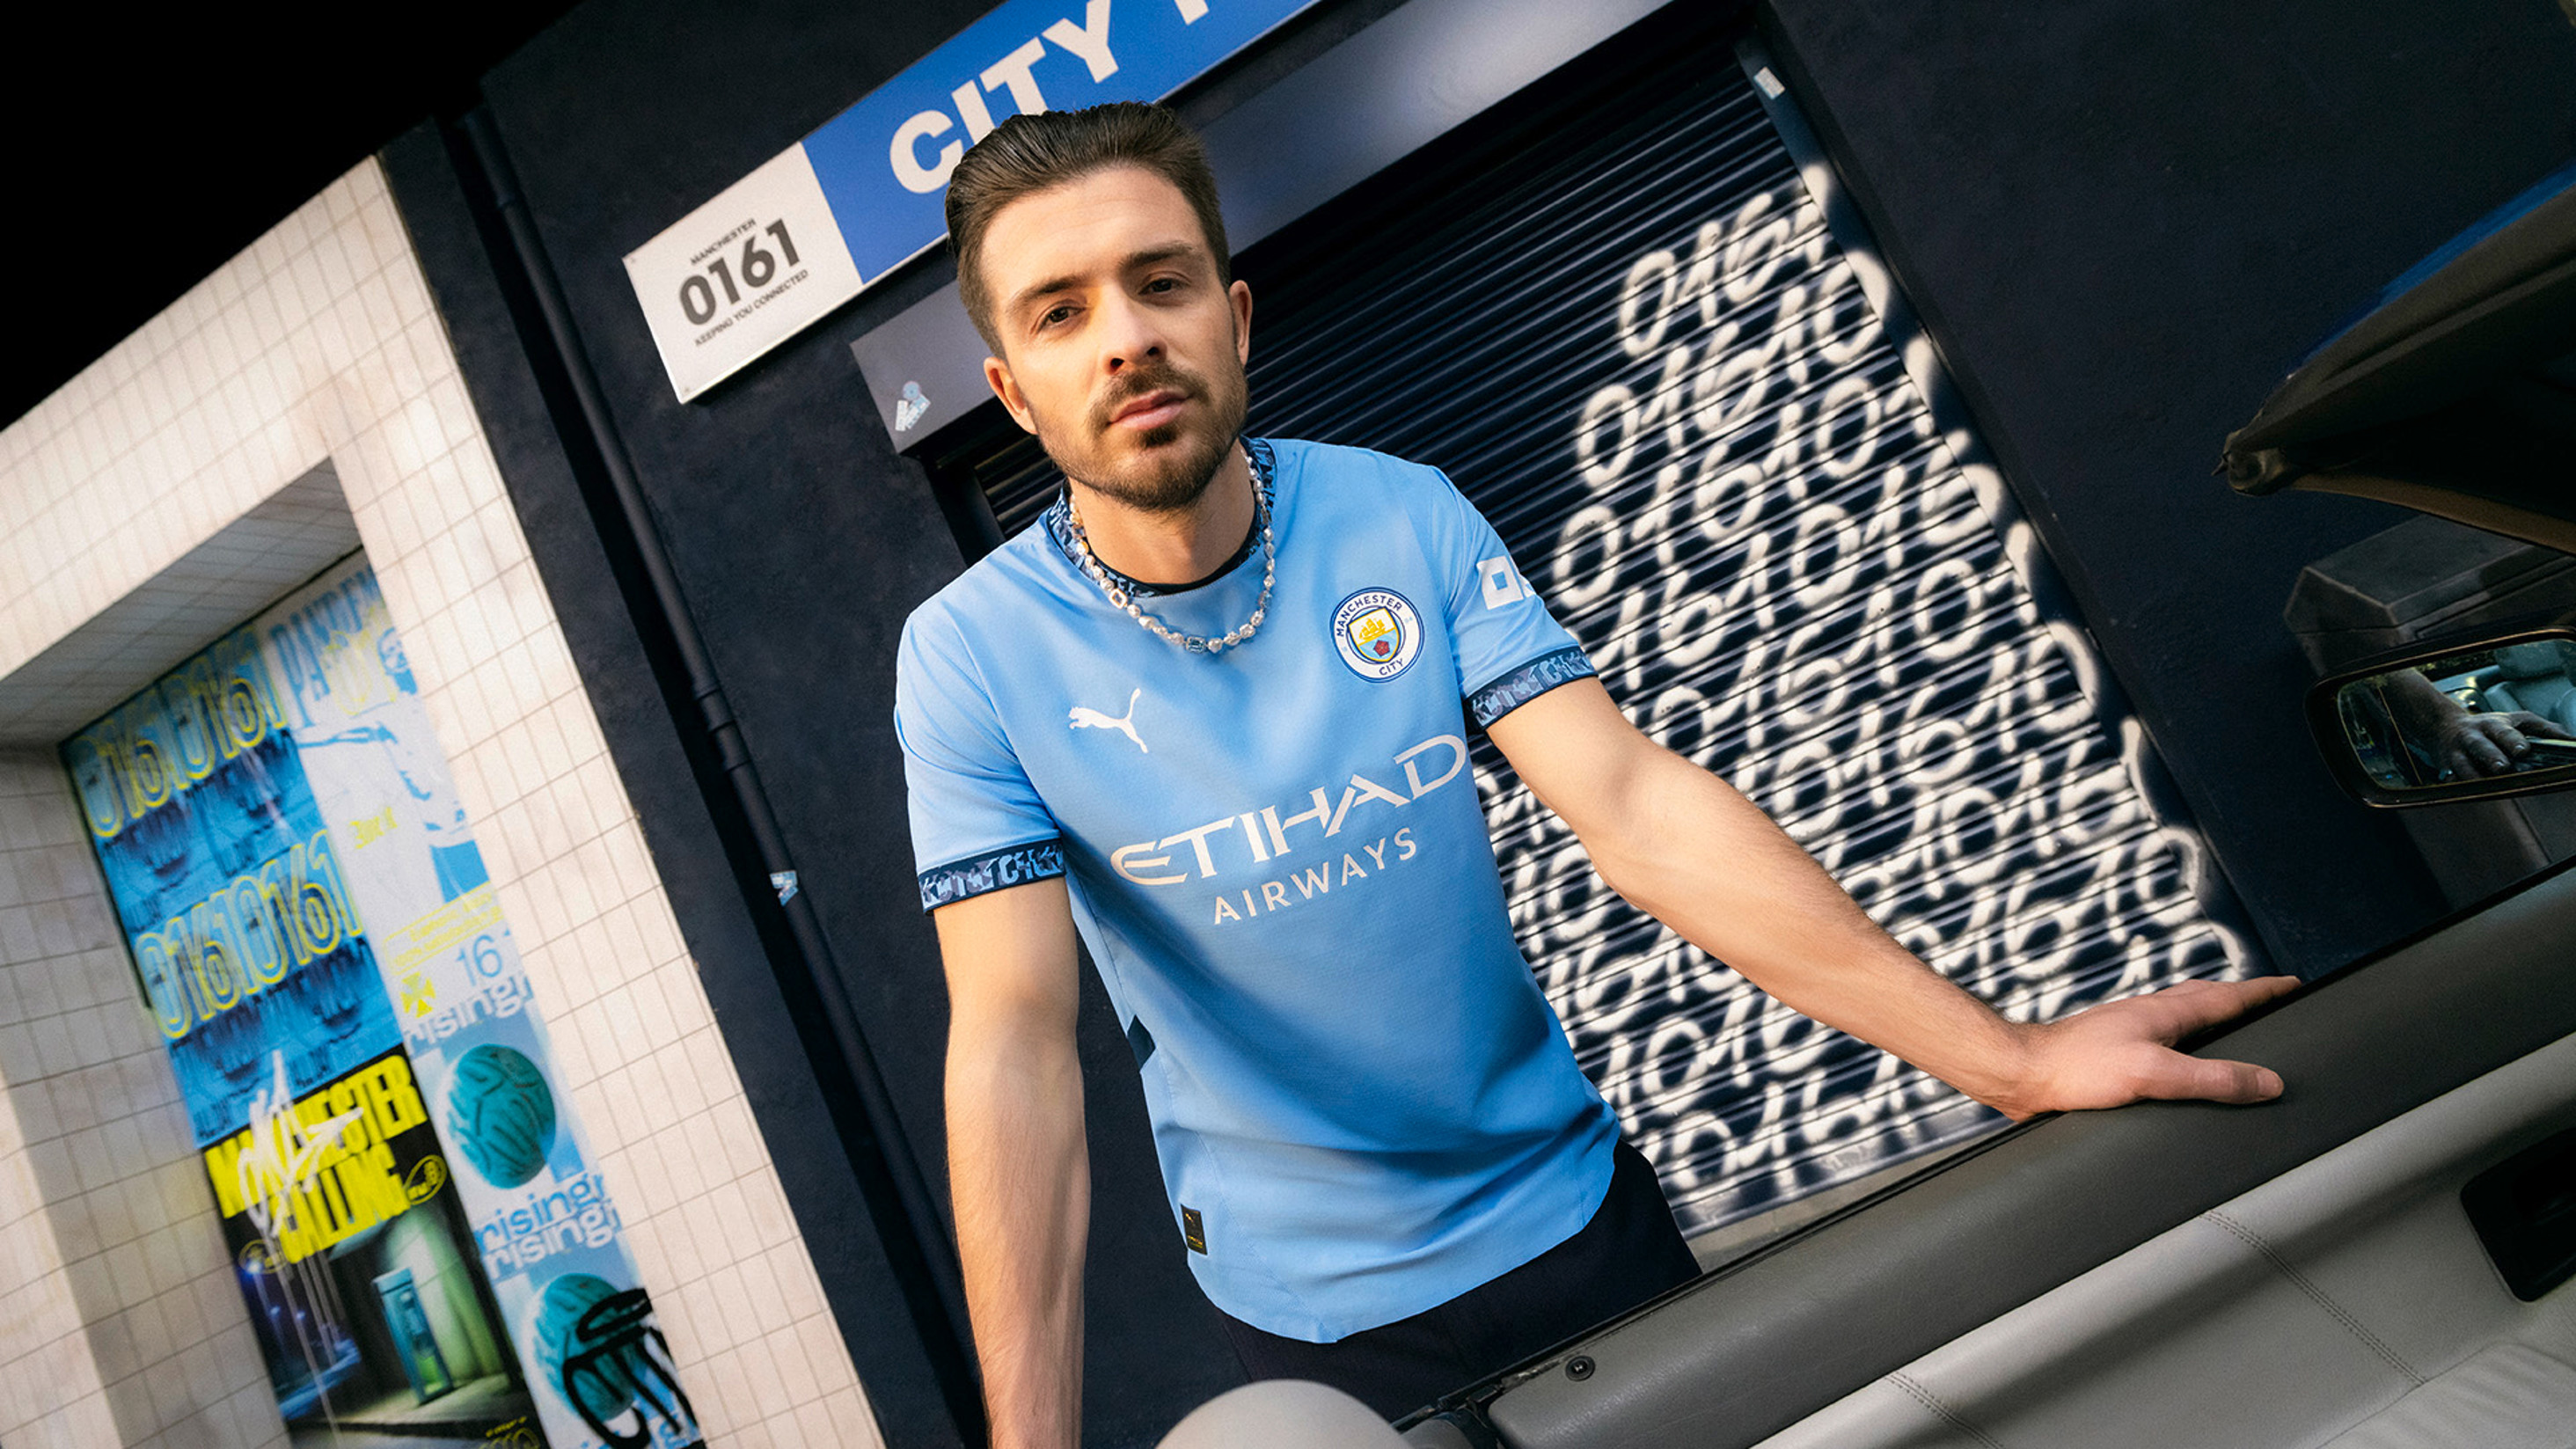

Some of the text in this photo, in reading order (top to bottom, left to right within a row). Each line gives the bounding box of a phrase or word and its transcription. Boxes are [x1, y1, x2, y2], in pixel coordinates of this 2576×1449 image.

[889, 0, 1119, 194] CITY
[678, 218, 801, 326] 0161
[690, 218, 757, 265] MANCHESTER
[695, 269, 809, 347] KEEPING YOU CONNECTED
[1336, 594, 1402, 637] MANCHESTER
[1379, 658, 1404, 676] CITY
[1110, 734, 1467, 886] ETIHAD
[1214, 827, 1416, 926] AIRWAYS
